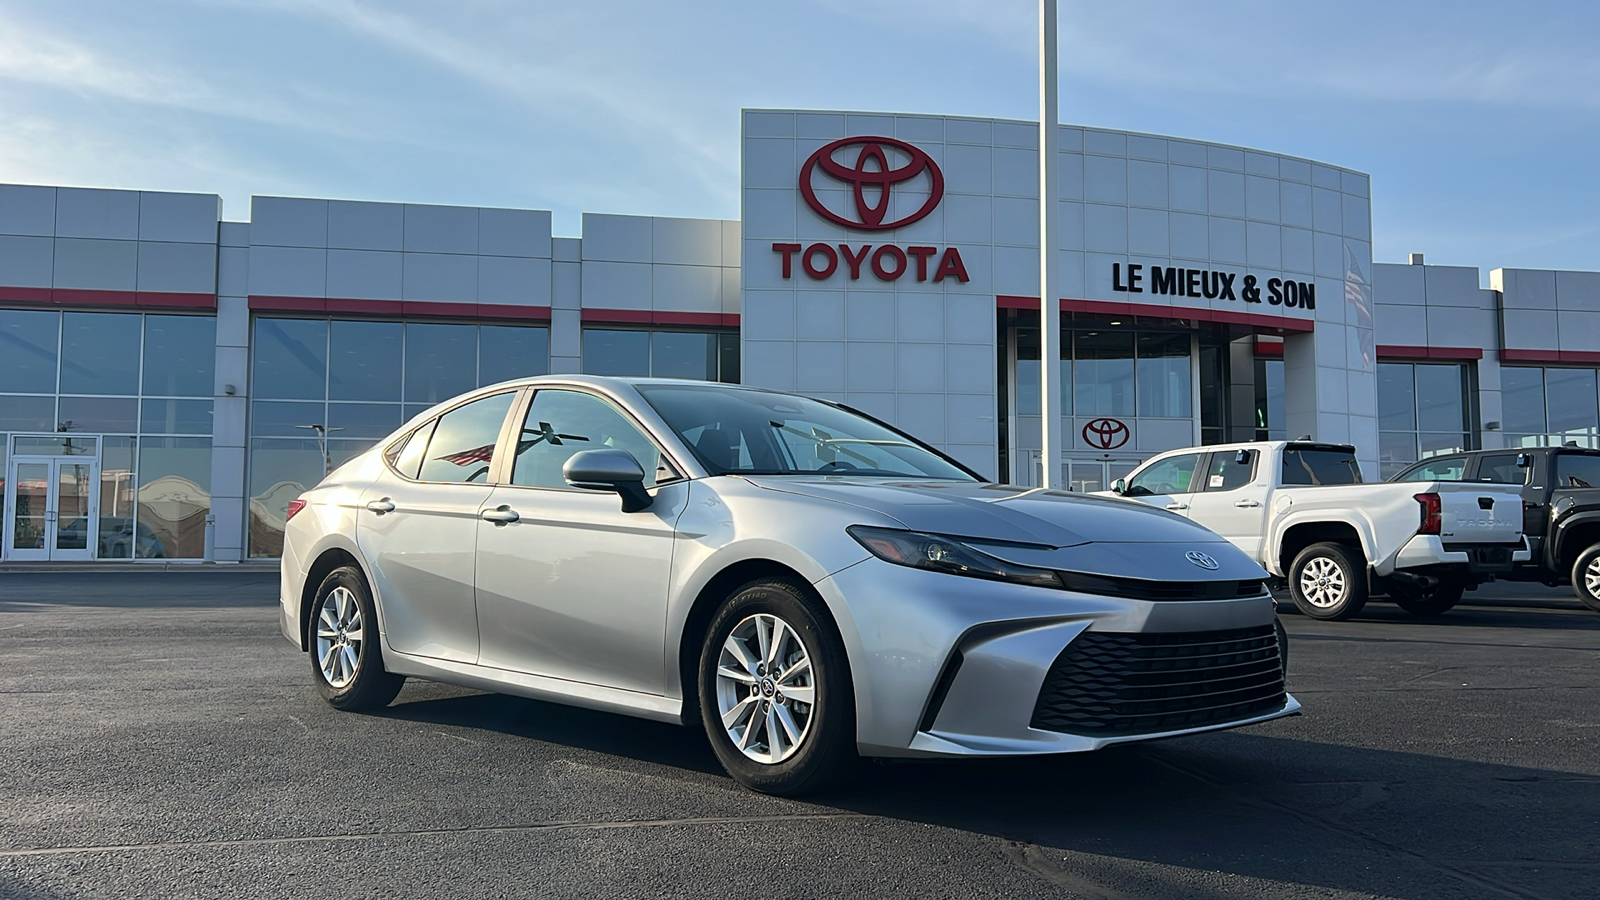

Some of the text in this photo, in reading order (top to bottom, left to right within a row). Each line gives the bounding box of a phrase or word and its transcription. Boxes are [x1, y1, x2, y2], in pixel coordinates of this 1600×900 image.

[772, 242, 970, 284] TOYOTA
[1112, 262, 1316, 310] LE MIEUX & SON
[1457, 518, 1514, 528] TACOMA
